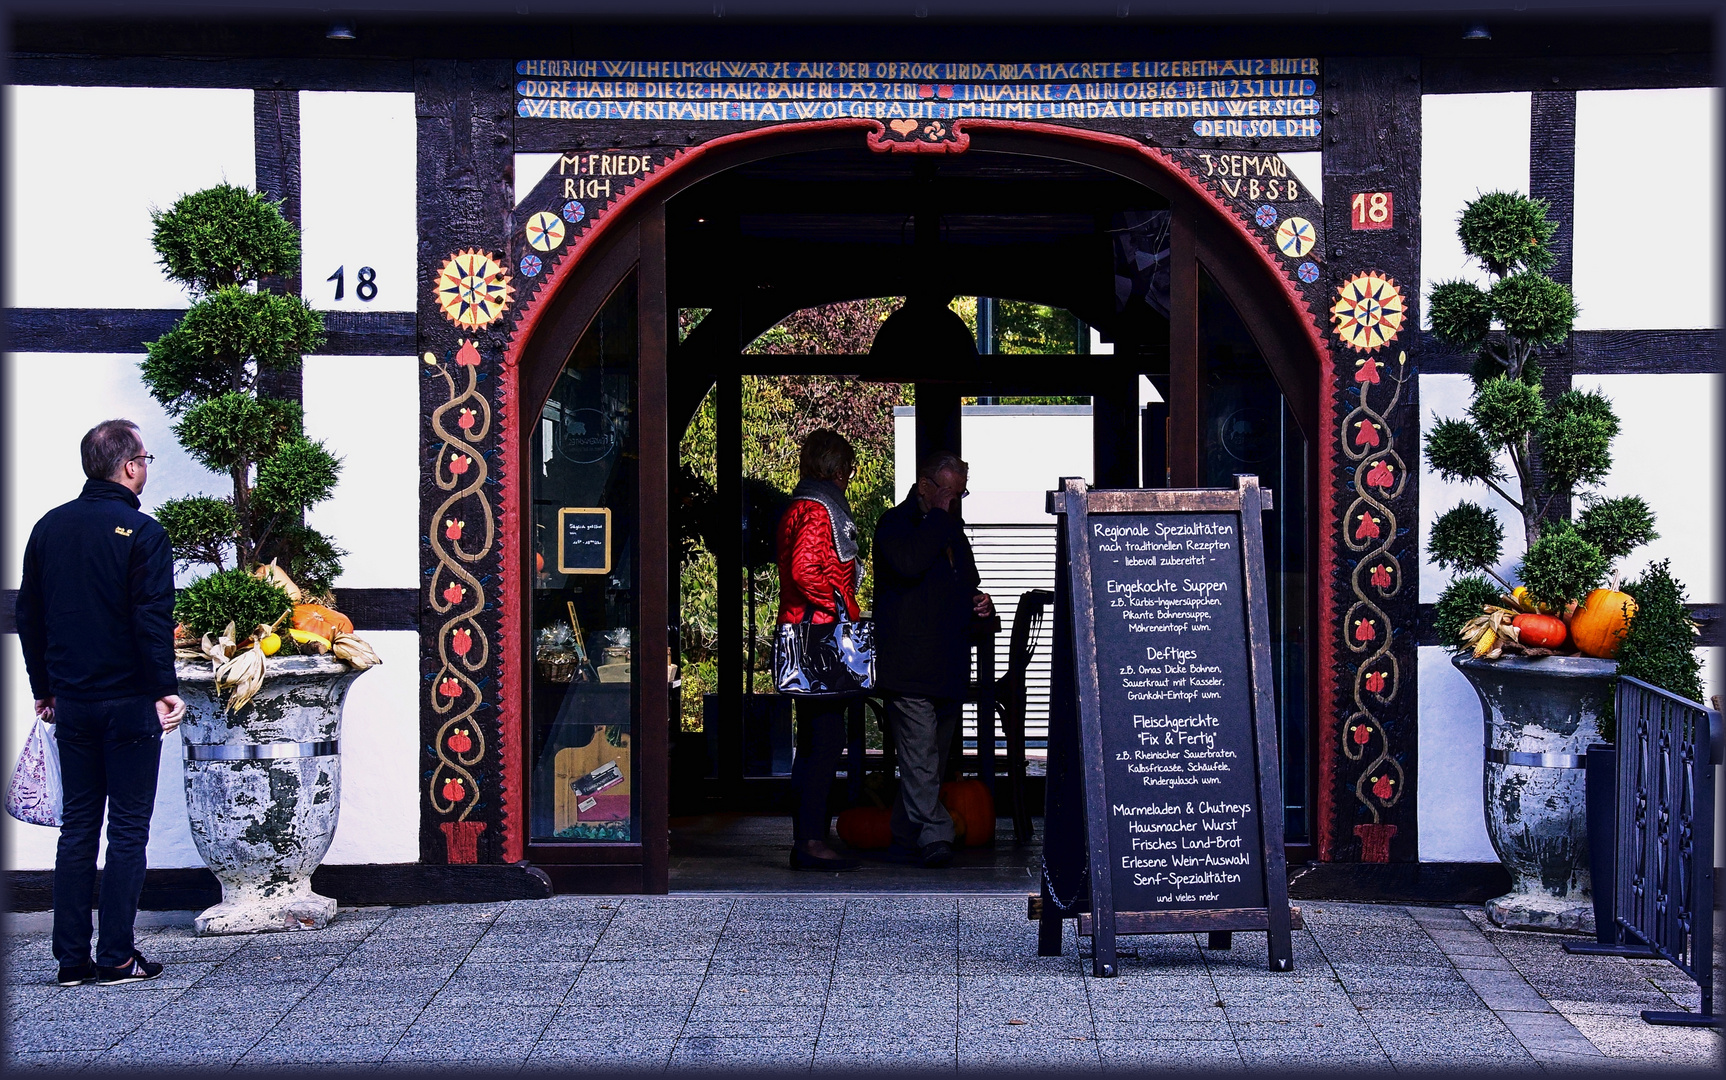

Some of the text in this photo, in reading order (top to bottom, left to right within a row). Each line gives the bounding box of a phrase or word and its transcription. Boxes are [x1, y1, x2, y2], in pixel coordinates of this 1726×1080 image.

[526, 60, 597, 77] HENRICH
[1352, 192, 1388, 224] 18
[326, 264, 379, 302] 18
[1093, 522, 1233, 542] Regionale Spezialitäten
[1099, 540, 1231, 553] nach traditionellen Rezepten
[1125, 556, 1157, 566] liebevoll
[1160, 555, 1206, 566] zubereitet
[1107, 578, 1228, 598] Eingekochte Suppen
[1110, 598, 1127, 607] z.B.
[1123, 610, 1154, 620] Pikante
[1191, 624, 1211, 632] uvm.
[1147, 647, 1197, 664] Deftiges
[1120, 666, 1136, 675] z.B.
[1139, 665, 1162, 674] Omas
[1165, 664, 1187, 674] Dicke
[1122, 678, 1170, 687] Sauerkraut
[1173, 678, 1187, 686] mit
[1128, 690, 1198, 703] Grünkohl-Eintopf
[1133, 714, 1220, 732] Fleischgerichte
[1165, 732, 1174, 745] &
[1116, 751, 1132, 760] z.B.
[1135, 750, 1181, 759] Rheinischer
[1143, 776, 1198, 788] Rindergulasch
[1113, 801, 1251, 818] Marmeladen & Chutneys
[1129, 818, 1238, 833] Hausmacher Wurst
[1132, 836, 1242, 850] Frisches Land-Brot
[1122, 853, 1250, 869] Erlesene Wein-Auswahl
[1133, 871, 1241, 889] Senf-Spezialitäten
[1157, 892, 1220, 903] und vieles mehr
